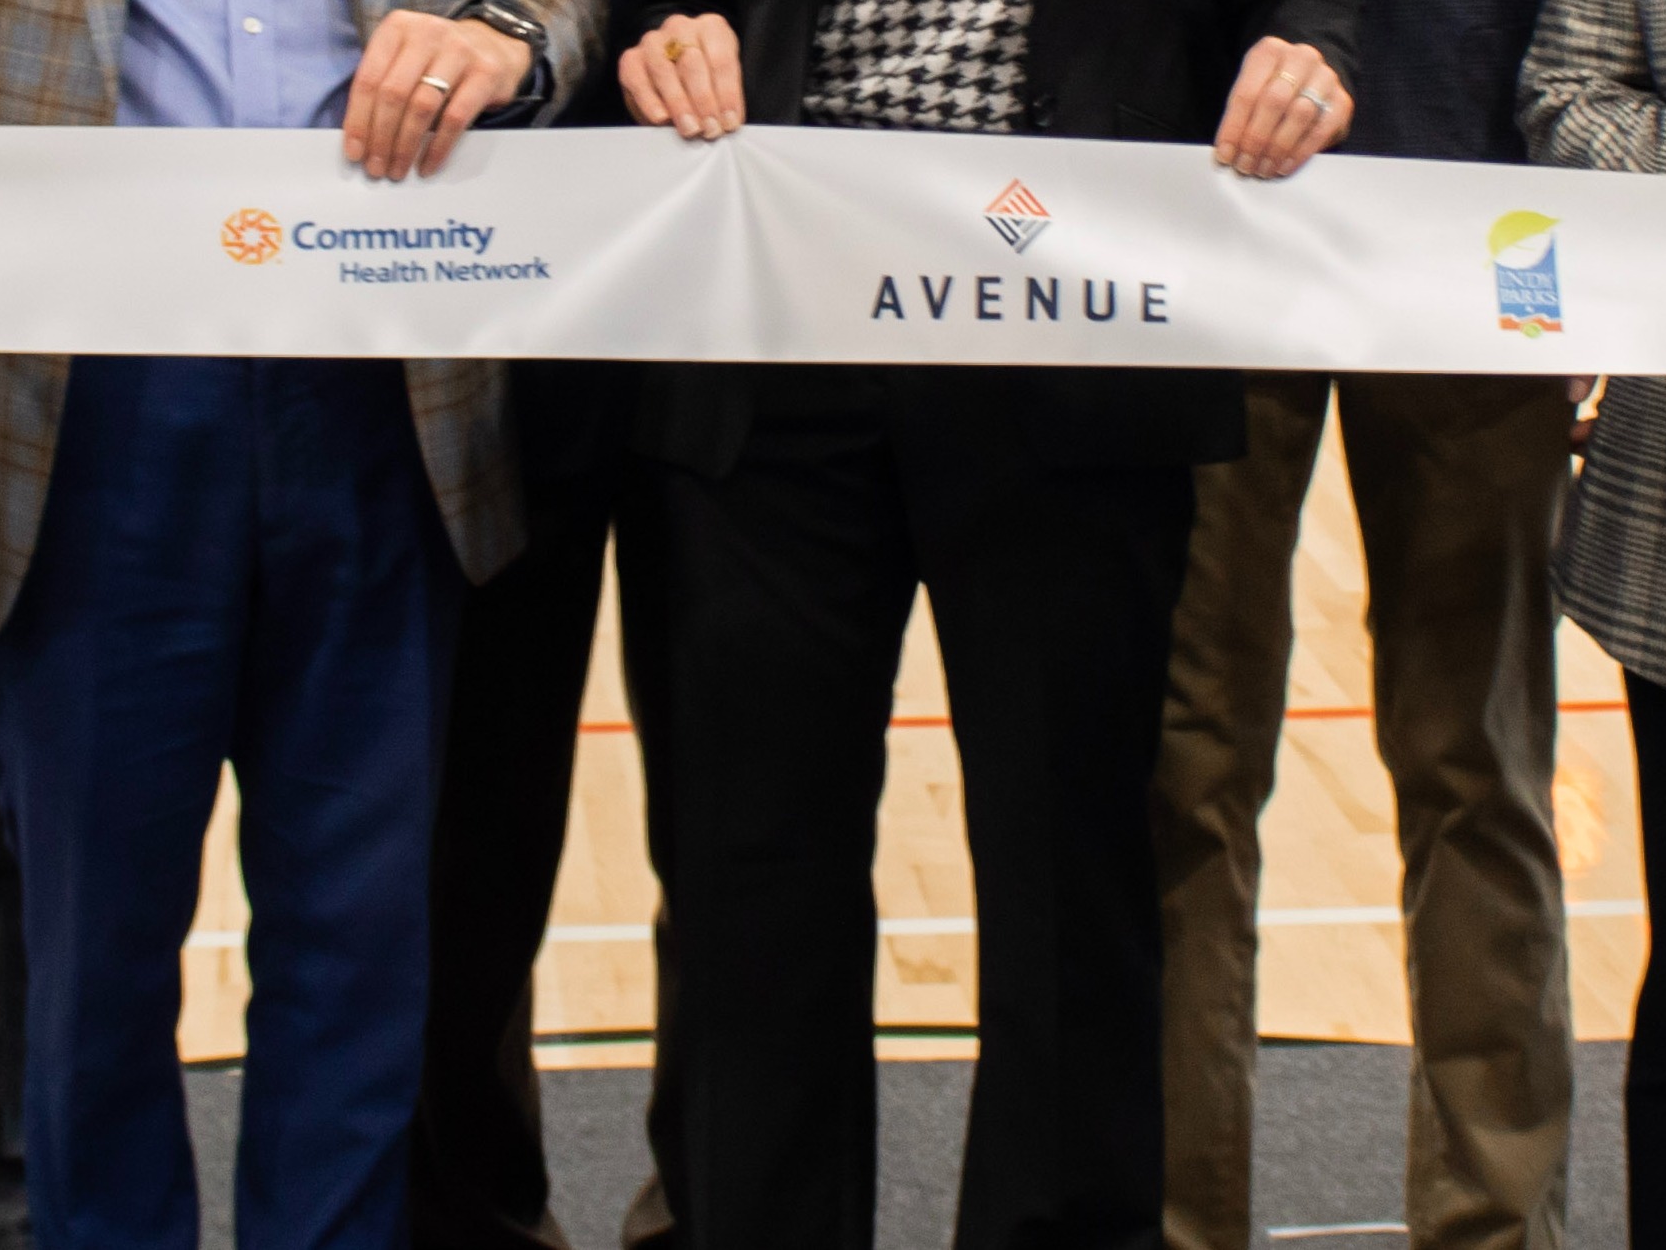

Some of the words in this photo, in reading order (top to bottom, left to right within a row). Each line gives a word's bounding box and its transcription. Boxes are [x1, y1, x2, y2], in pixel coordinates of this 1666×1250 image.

[291, 219, 494, 255] Community
[339, 260, 428, 283] Health
[433, 256, 550, 283] Network
[870, 275, 1169, 324] AVENUE
